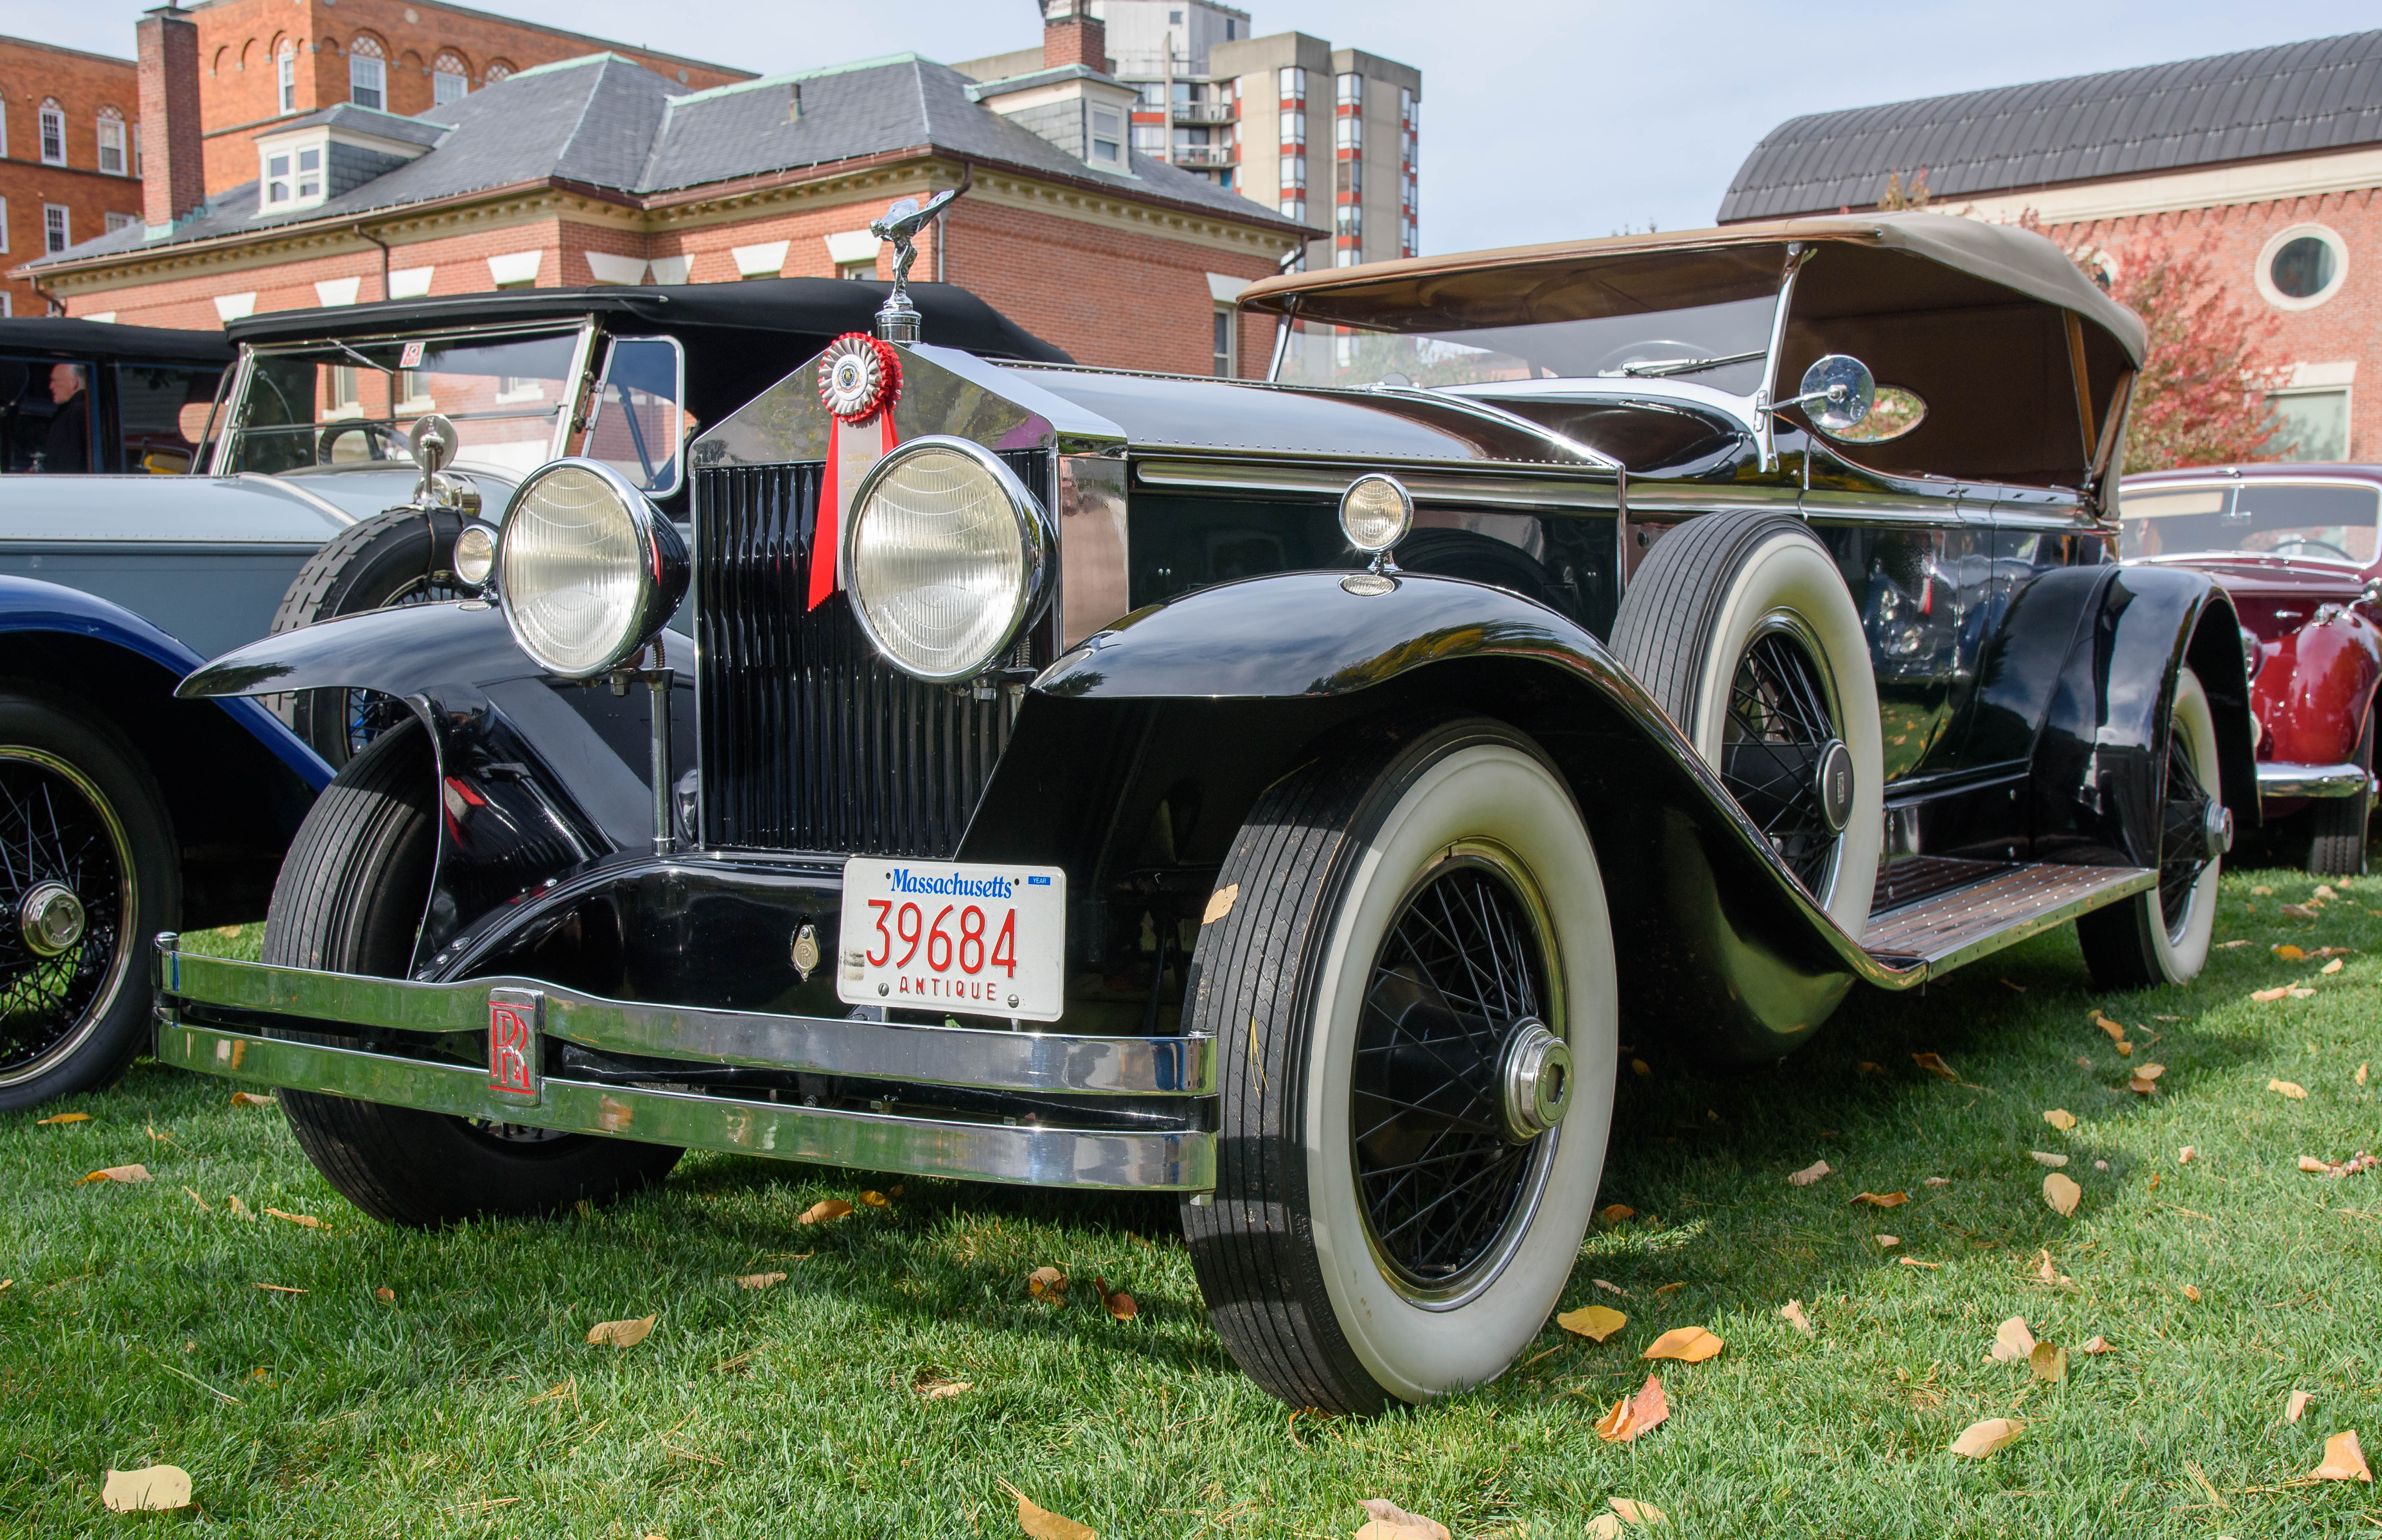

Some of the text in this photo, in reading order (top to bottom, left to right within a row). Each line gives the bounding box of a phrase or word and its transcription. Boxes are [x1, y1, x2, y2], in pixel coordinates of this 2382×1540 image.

[891, 869, 1012, 898] Massachusetts
[866, 899, 1016, 978] 39684
[899, 976, 996, 1001] ANTIQUE
